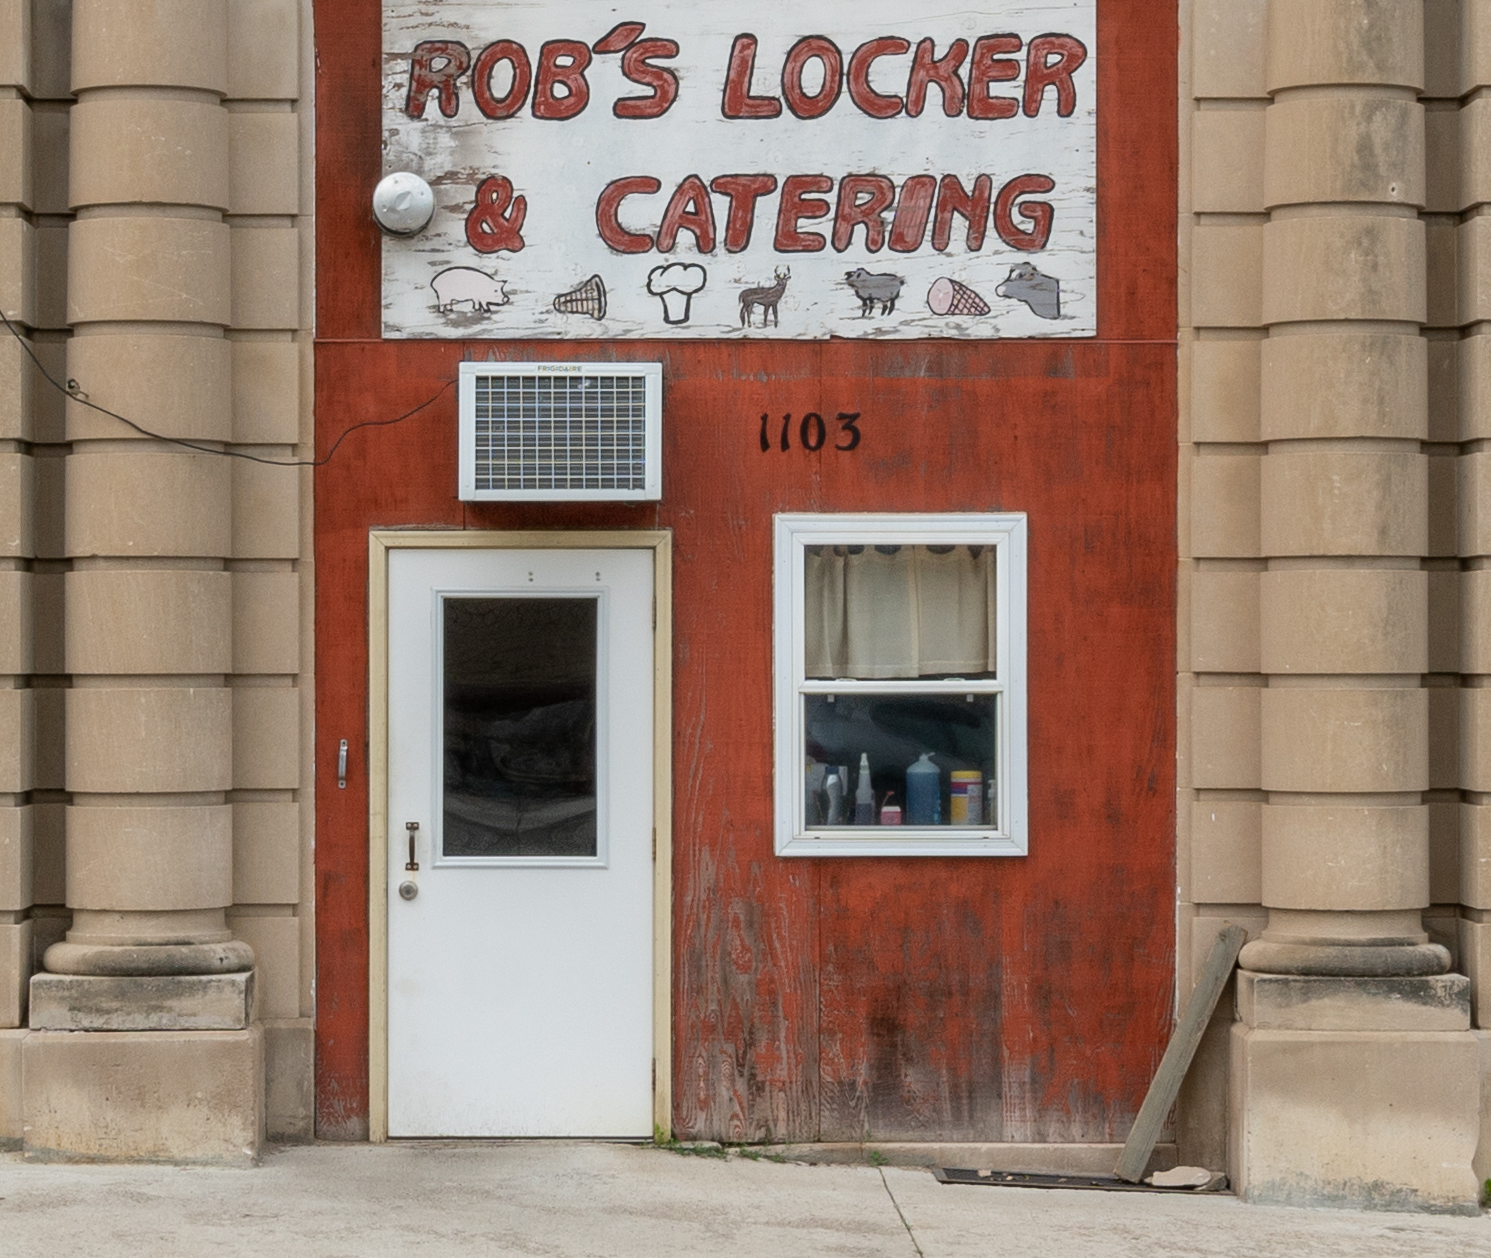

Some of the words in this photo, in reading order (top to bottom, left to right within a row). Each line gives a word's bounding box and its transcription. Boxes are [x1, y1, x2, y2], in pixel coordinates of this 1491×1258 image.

[407, 22, 680, 120] ROB'S
[721, 32, 1087, 120] LOCKER
[465, 175, 527, 254] &
[595, 174, 1055, 254] CATERING
[760, 412, 861, 452] 1103
